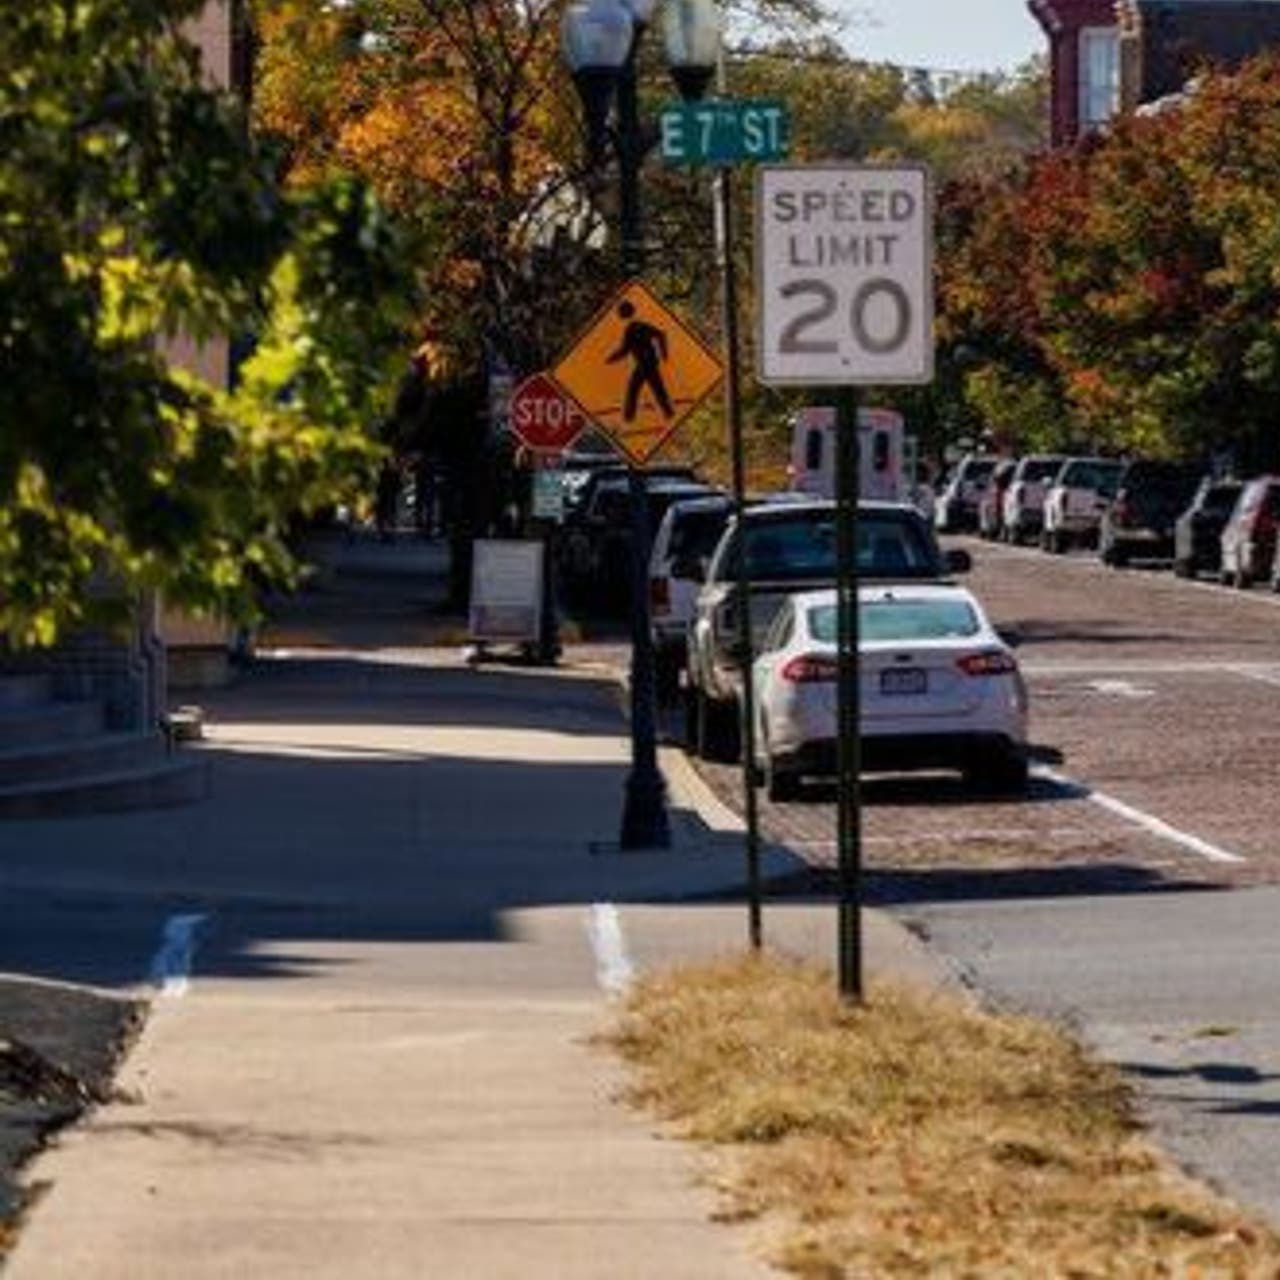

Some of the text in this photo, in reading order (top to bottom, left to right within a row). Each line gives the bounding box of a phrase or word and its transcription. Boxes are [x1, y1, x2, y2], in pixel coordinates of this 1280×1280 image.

[661, 112, 684, 156] E
[774, 189, 915, 221] SPEED
[790, 235, 898, 266] LIMIT
[779, 277, 912, 355] 20
